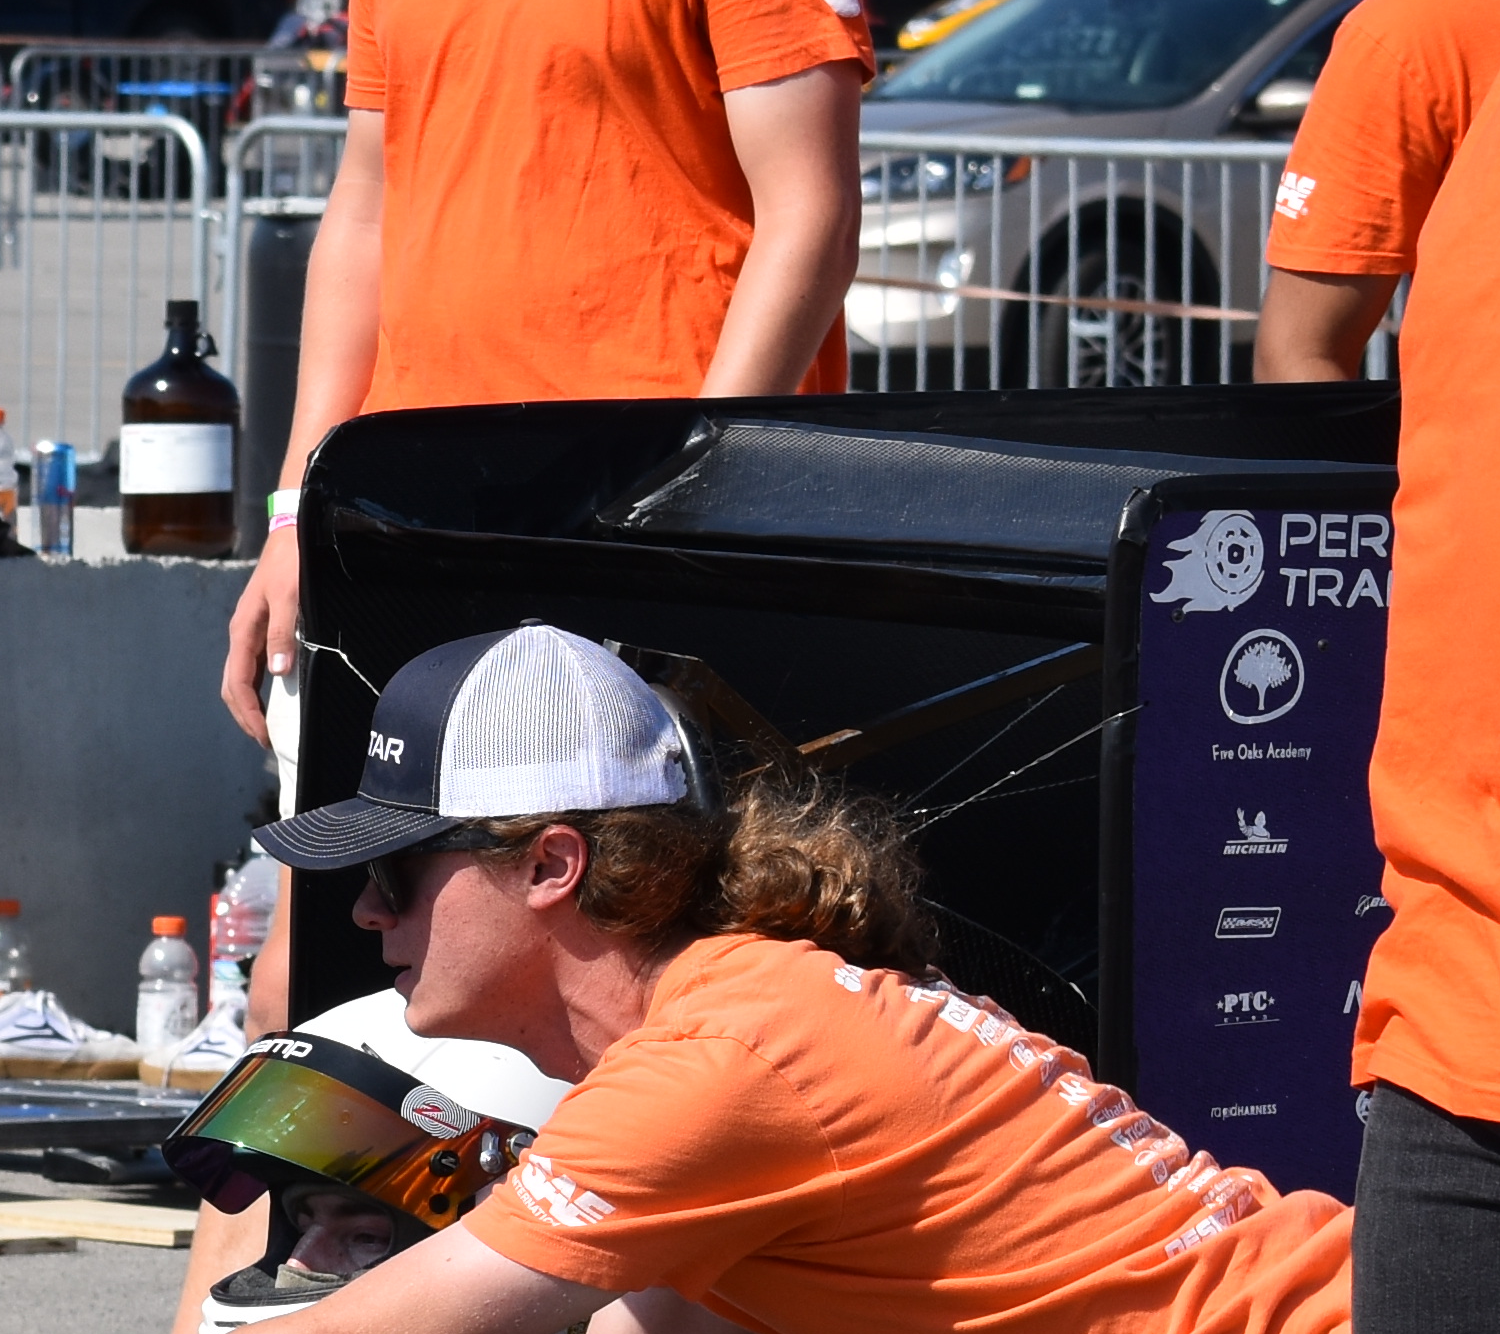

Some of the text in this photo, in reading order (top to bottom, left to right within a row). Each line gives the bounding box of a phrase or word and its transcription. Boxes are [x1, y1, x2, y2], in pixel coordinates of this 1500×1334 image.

[1212, 741, 1312, 761] Five Oaks Academy
[1223, 843, 1288, 856] MICHELIN
[1224, 991, 1268, 1013] PTC
[521, 1153, 617, 1227] SAE
